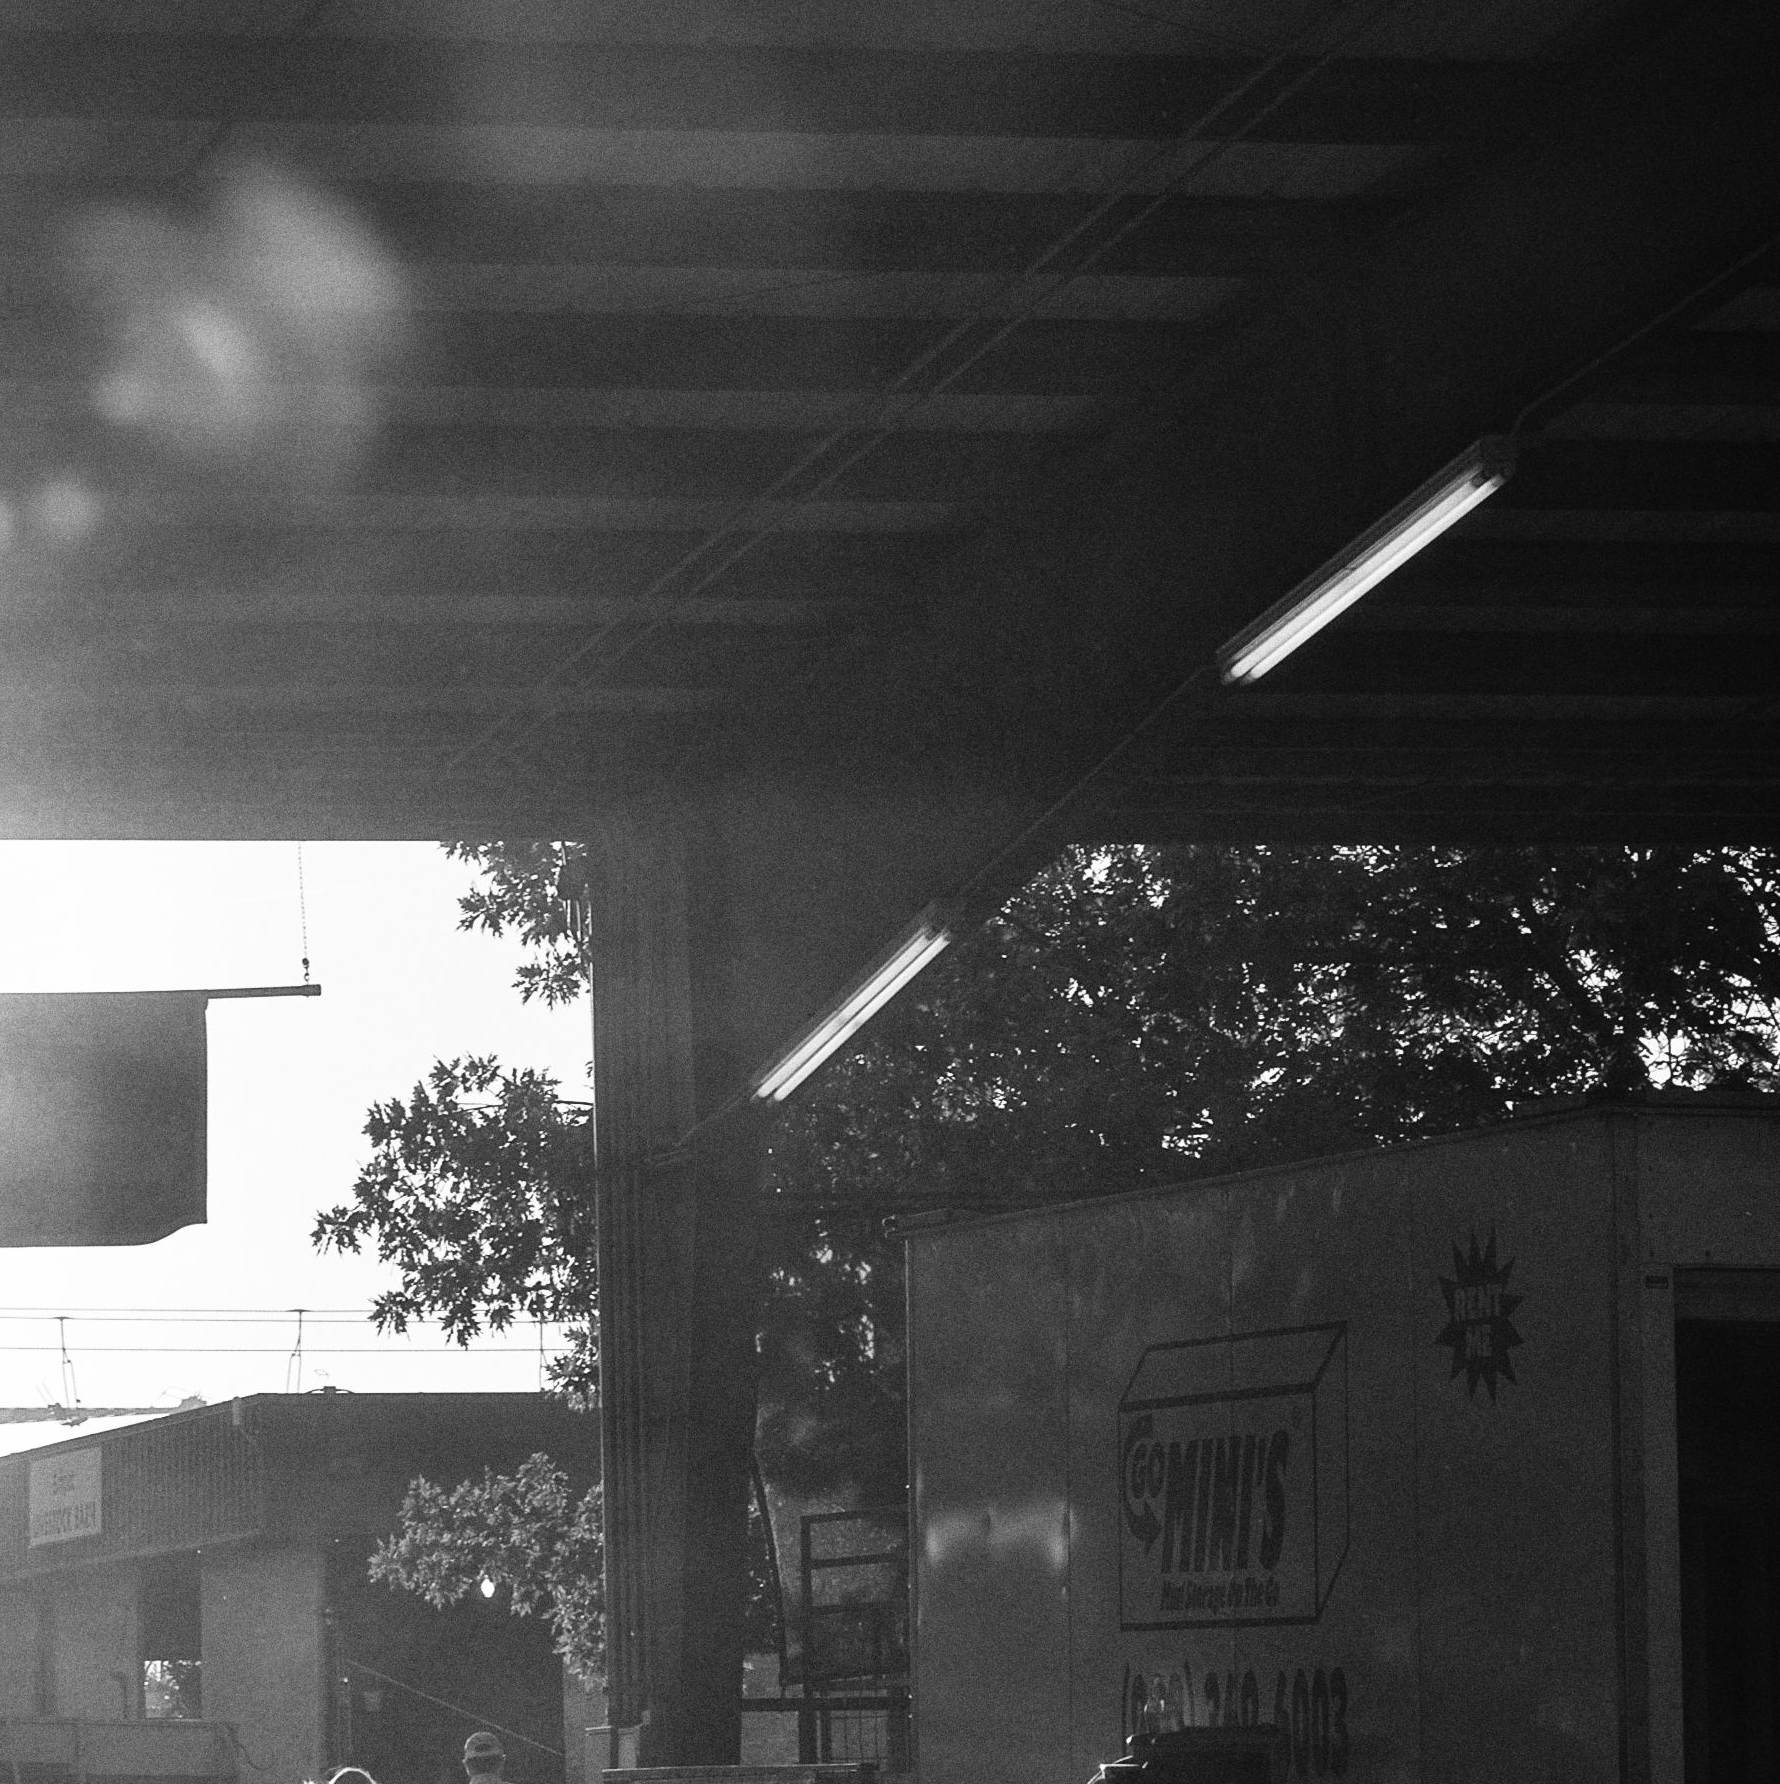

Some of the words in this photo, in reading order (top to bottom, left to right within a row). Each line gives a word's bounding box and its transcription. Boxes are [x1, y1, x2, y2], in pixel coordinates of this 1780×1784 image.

[1453, 1282, 1503, 1322] RENT
[1464, 1323, 1493, 1359] ME
[1129, 1441, 1165, 1500] GO
[1161, 1430, 1290, 1573] MINI'S
[1186, 1581, 1225, 1616] Storage
